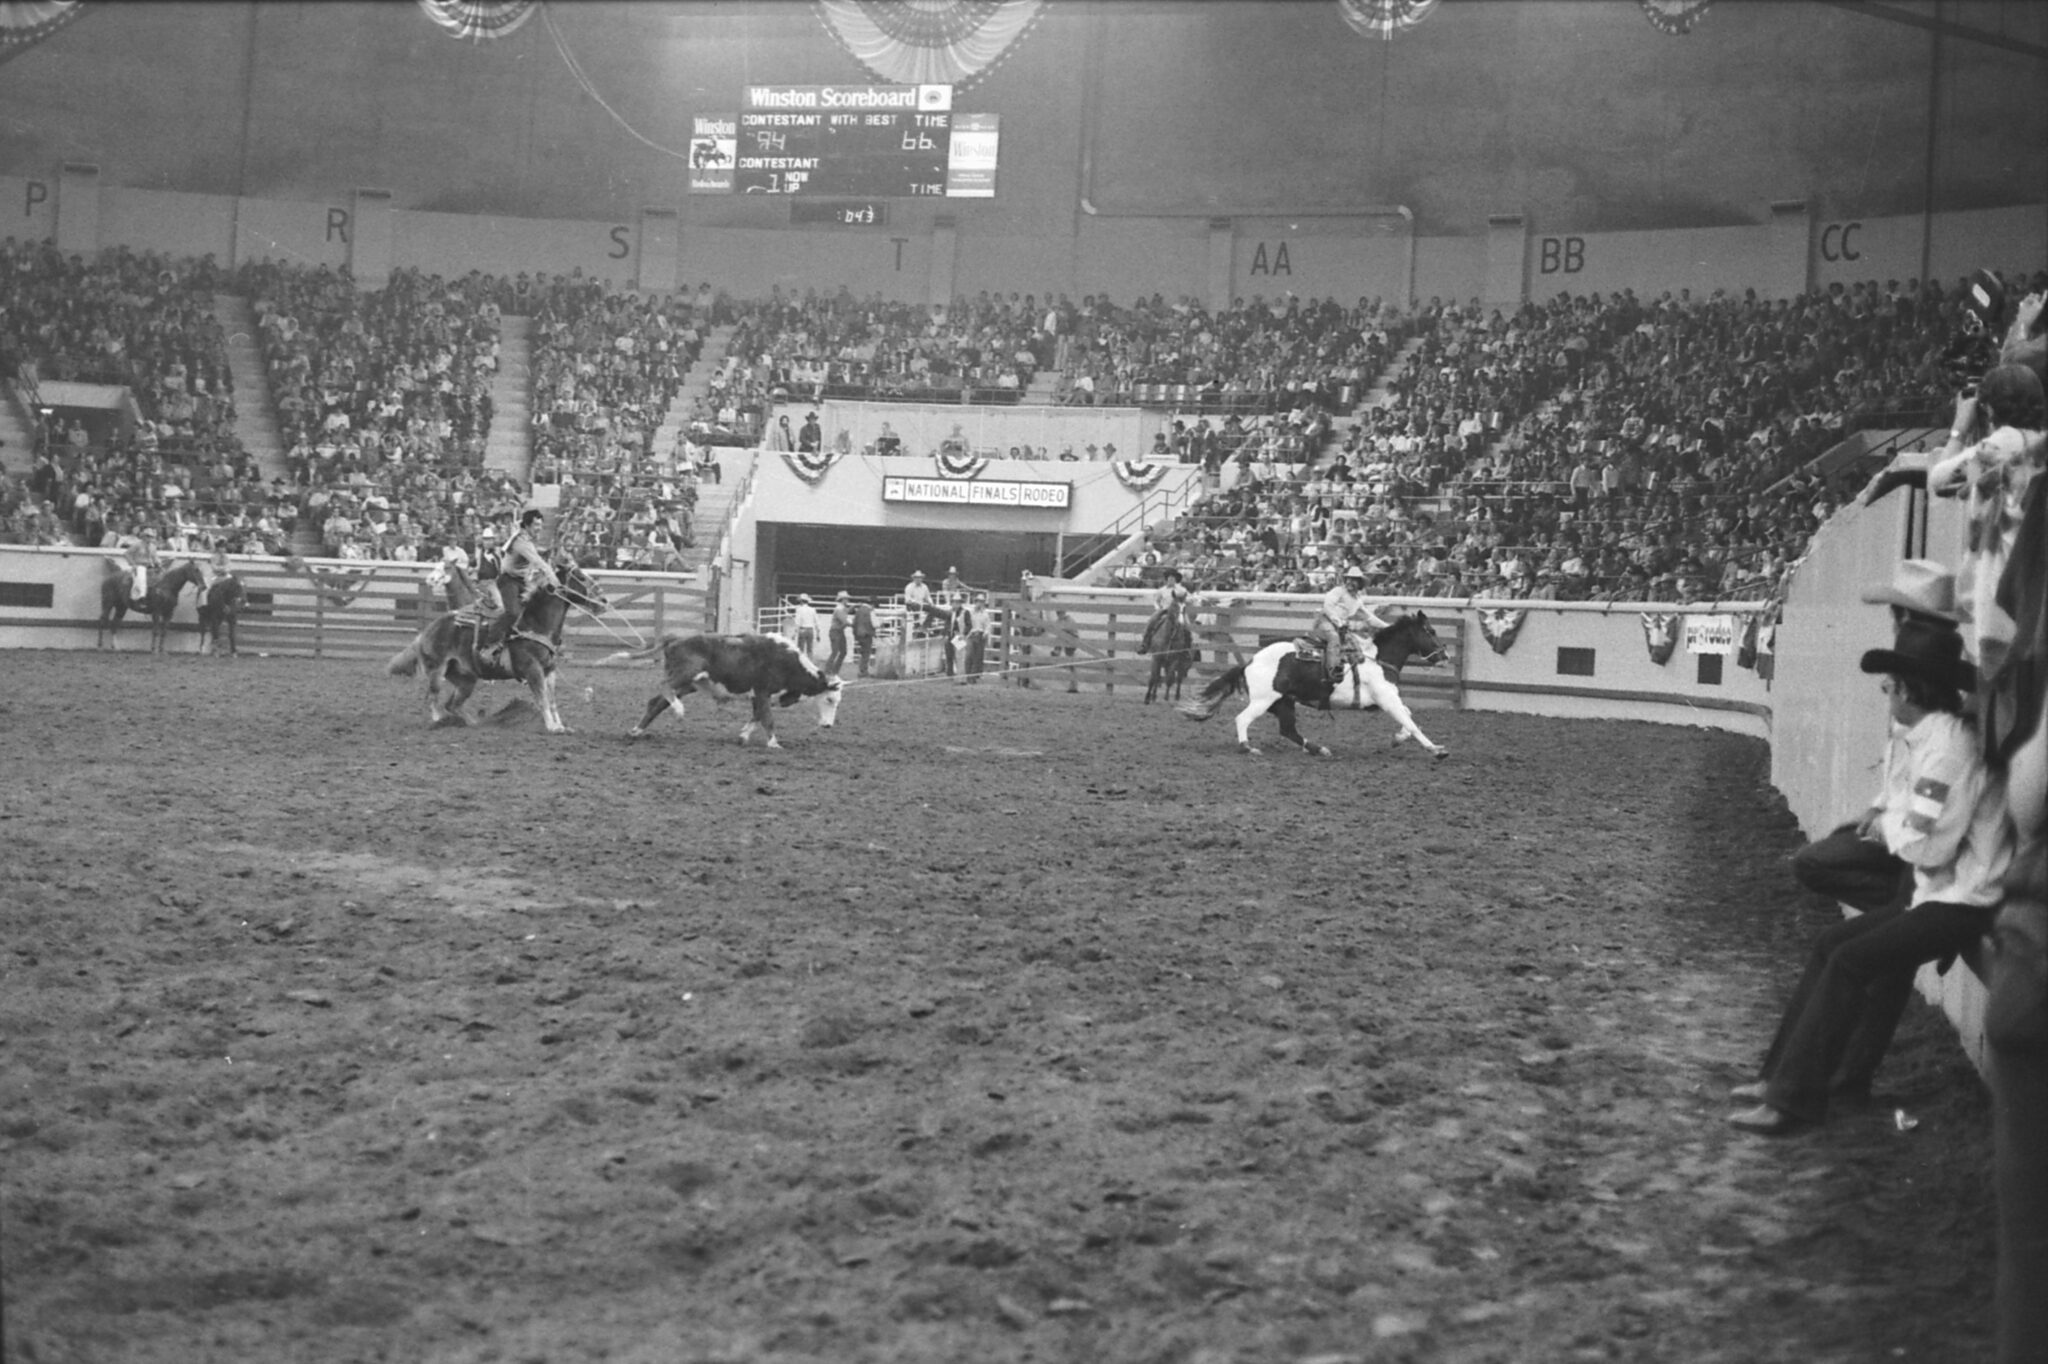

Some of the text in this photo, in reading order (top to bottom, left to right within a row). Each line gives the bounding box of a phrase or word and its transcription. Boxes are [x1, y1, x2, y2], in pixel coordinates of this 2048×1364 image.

[751, 87, 916, 107] Winston Scoreboard
[694, 118, 736, 135] Winston
[741, 114, 948, 127] CONTESTANT WITH BEST TIME
[738, 157, 819, 169] CONTESTANT
[785, 171, 809, 182] NOW
[784, 183, 801, 193] UP
[910, 184, 943, 194] TIME
[25, 181, 47, 216] P
[326, 207, 348, 242] R
[608, 226, 629, 259] S
[1821, 222, 1862, 262] CC
[890, 237, 909, 271] T
[1250, 241, 1292, 276] AA
[1541, 236, 1585, 274] BB
[907, 483, 1065, 503] NATIONAL FINALS RODEO
